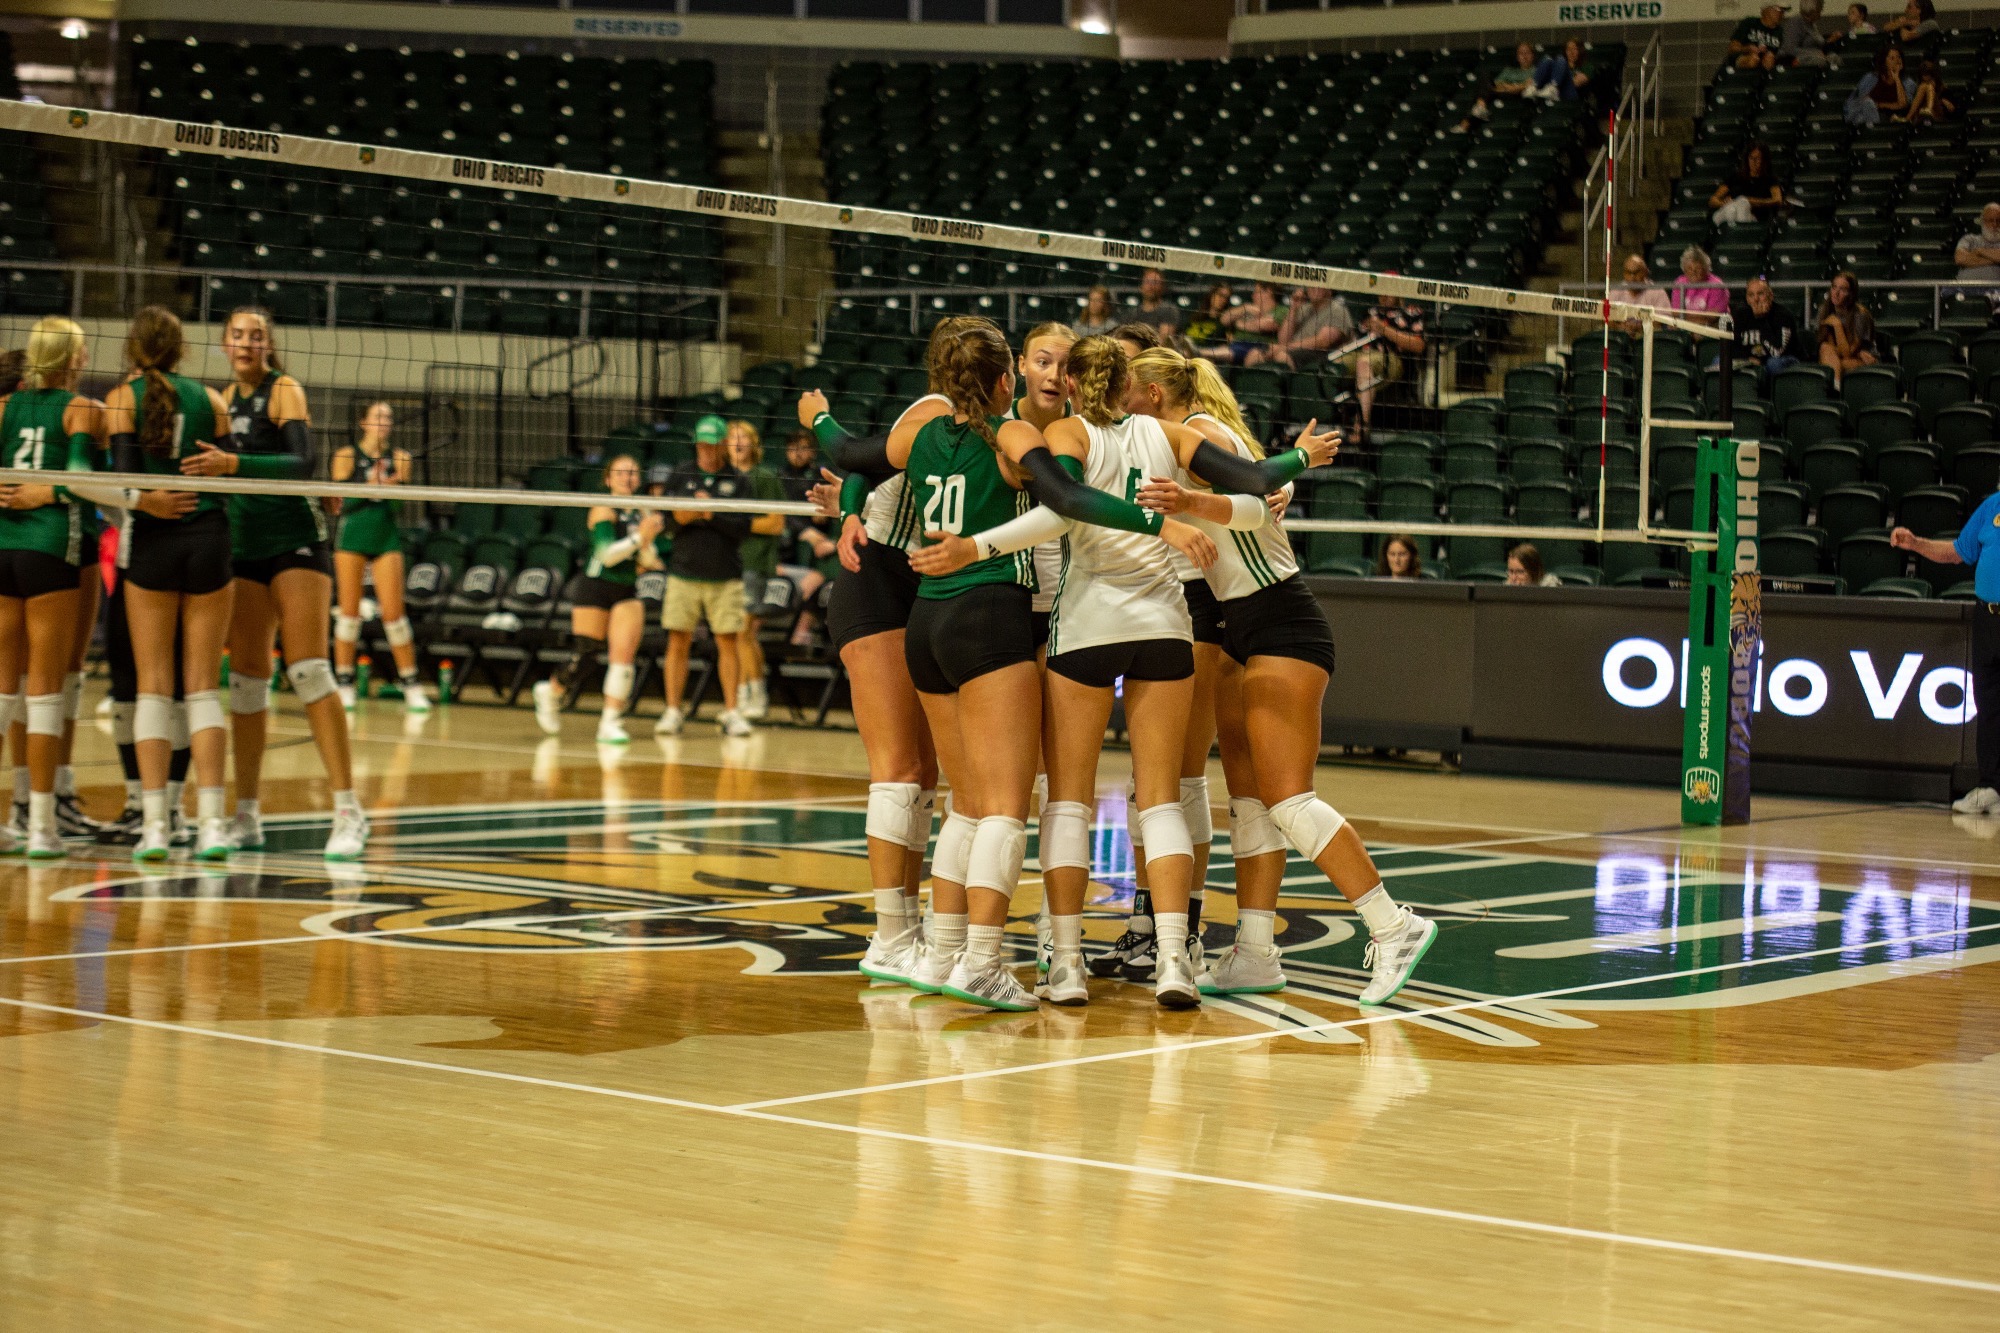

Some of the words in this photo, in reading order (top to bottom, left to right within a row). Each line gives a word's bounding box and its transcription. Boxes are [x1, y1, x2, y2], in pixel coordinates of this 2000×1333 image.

[1559, 2, 1662, 21] RESERVED
[574, 18, 682, 36] RESERVED
[176, 123, 214, 146] OHIO
[219, 128, 280, 154] BOBCATS
[454, 158, 486, 180] OHIO
[491, 163, 545, 187] BOBCATS
[696, 189, 726, 210] OHIO
[729, 194, 777, 216] BOBCATS
[912, 217, 938, 235] OHIO
[941, 220, 984, 241] BOBCATS
[1102, 241, 1126, 258] OHIO
[1128, 244, 1166, 263] BOBCATS
[13, 426, 46, 470] 21
[924, 474, 966, 535] 20
[1735, 442, 1760, 573] OHIO
[1700, 665, 1711, 707] sports
[1699, 709, 1710, 760] imports
